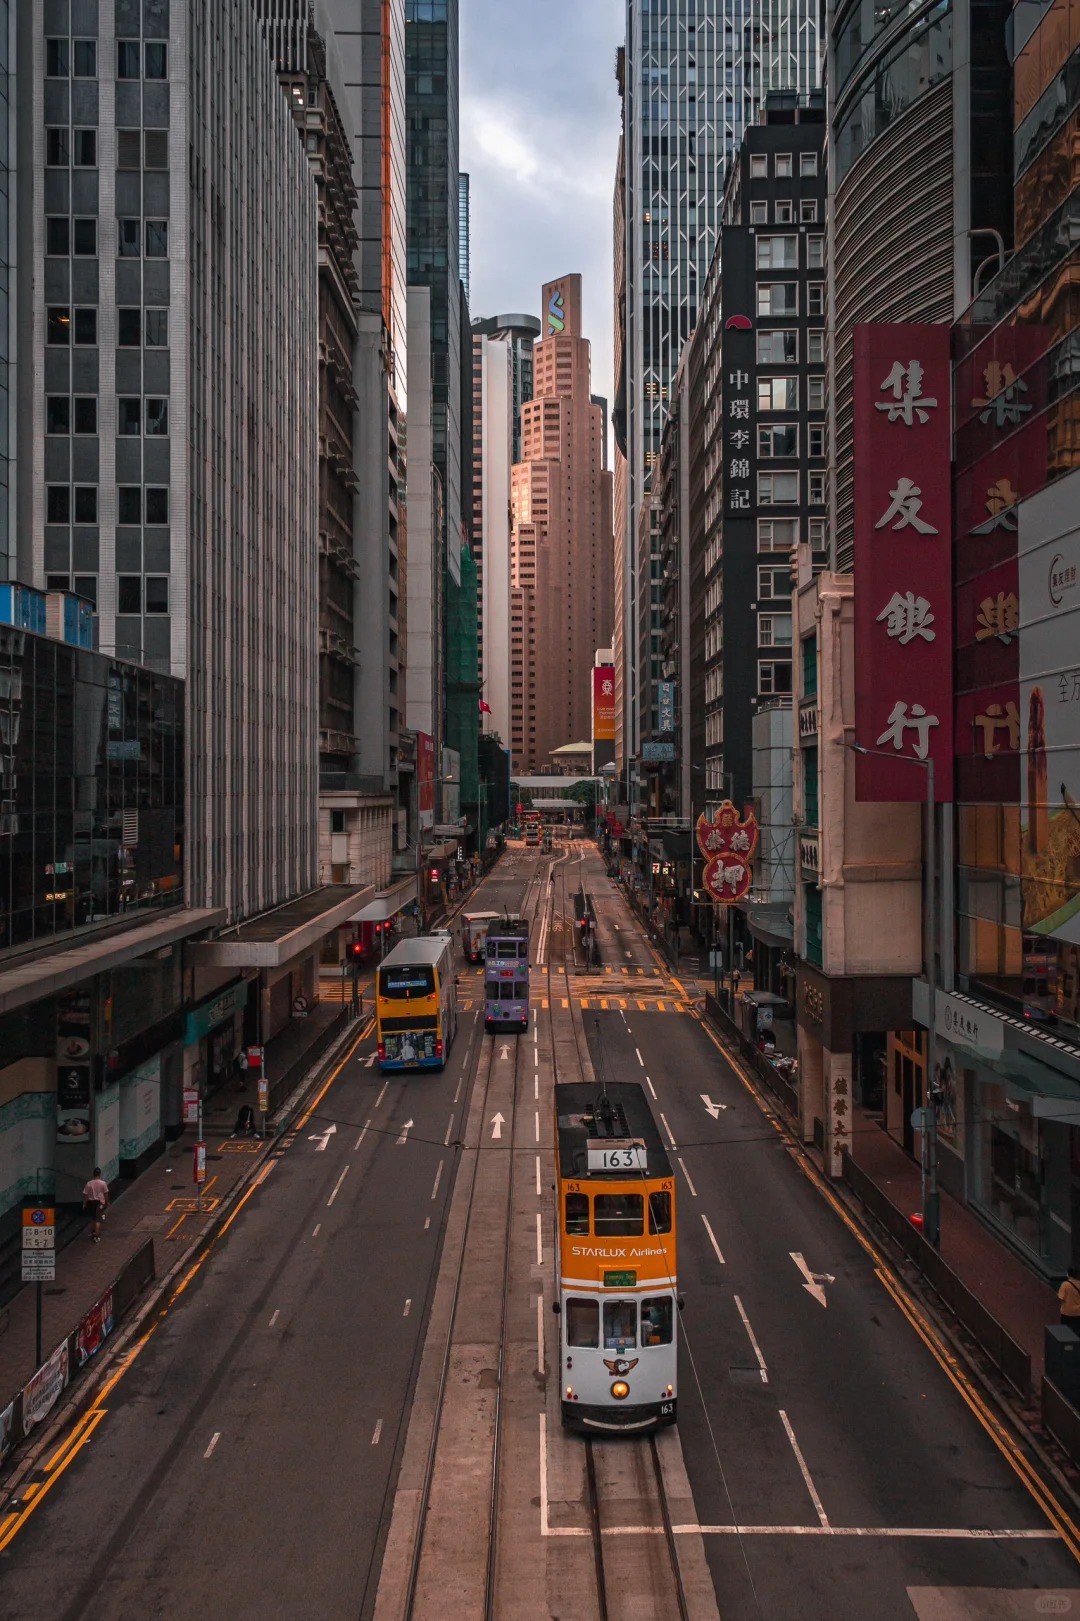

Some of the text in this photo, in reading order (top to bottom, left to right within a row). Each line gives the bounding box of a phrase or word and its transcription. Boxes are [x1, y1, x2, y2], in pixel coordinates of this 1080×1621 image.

[729, 369, 751, 509] 中環李錦記
[875, 359, 939, 759] 集友銀行
[1052, 566, 1077, 588] 集友理財
[710, 859, 746, 895] 押
[603, 1152, 634, 1168] 163
[567, 1183, 581, 1193] 163
[661, 1182, 673, 1192] 163
[571, 1246, 668, 1258] STARLUX Airlines
[661, 1403, 674, 1415] 163
